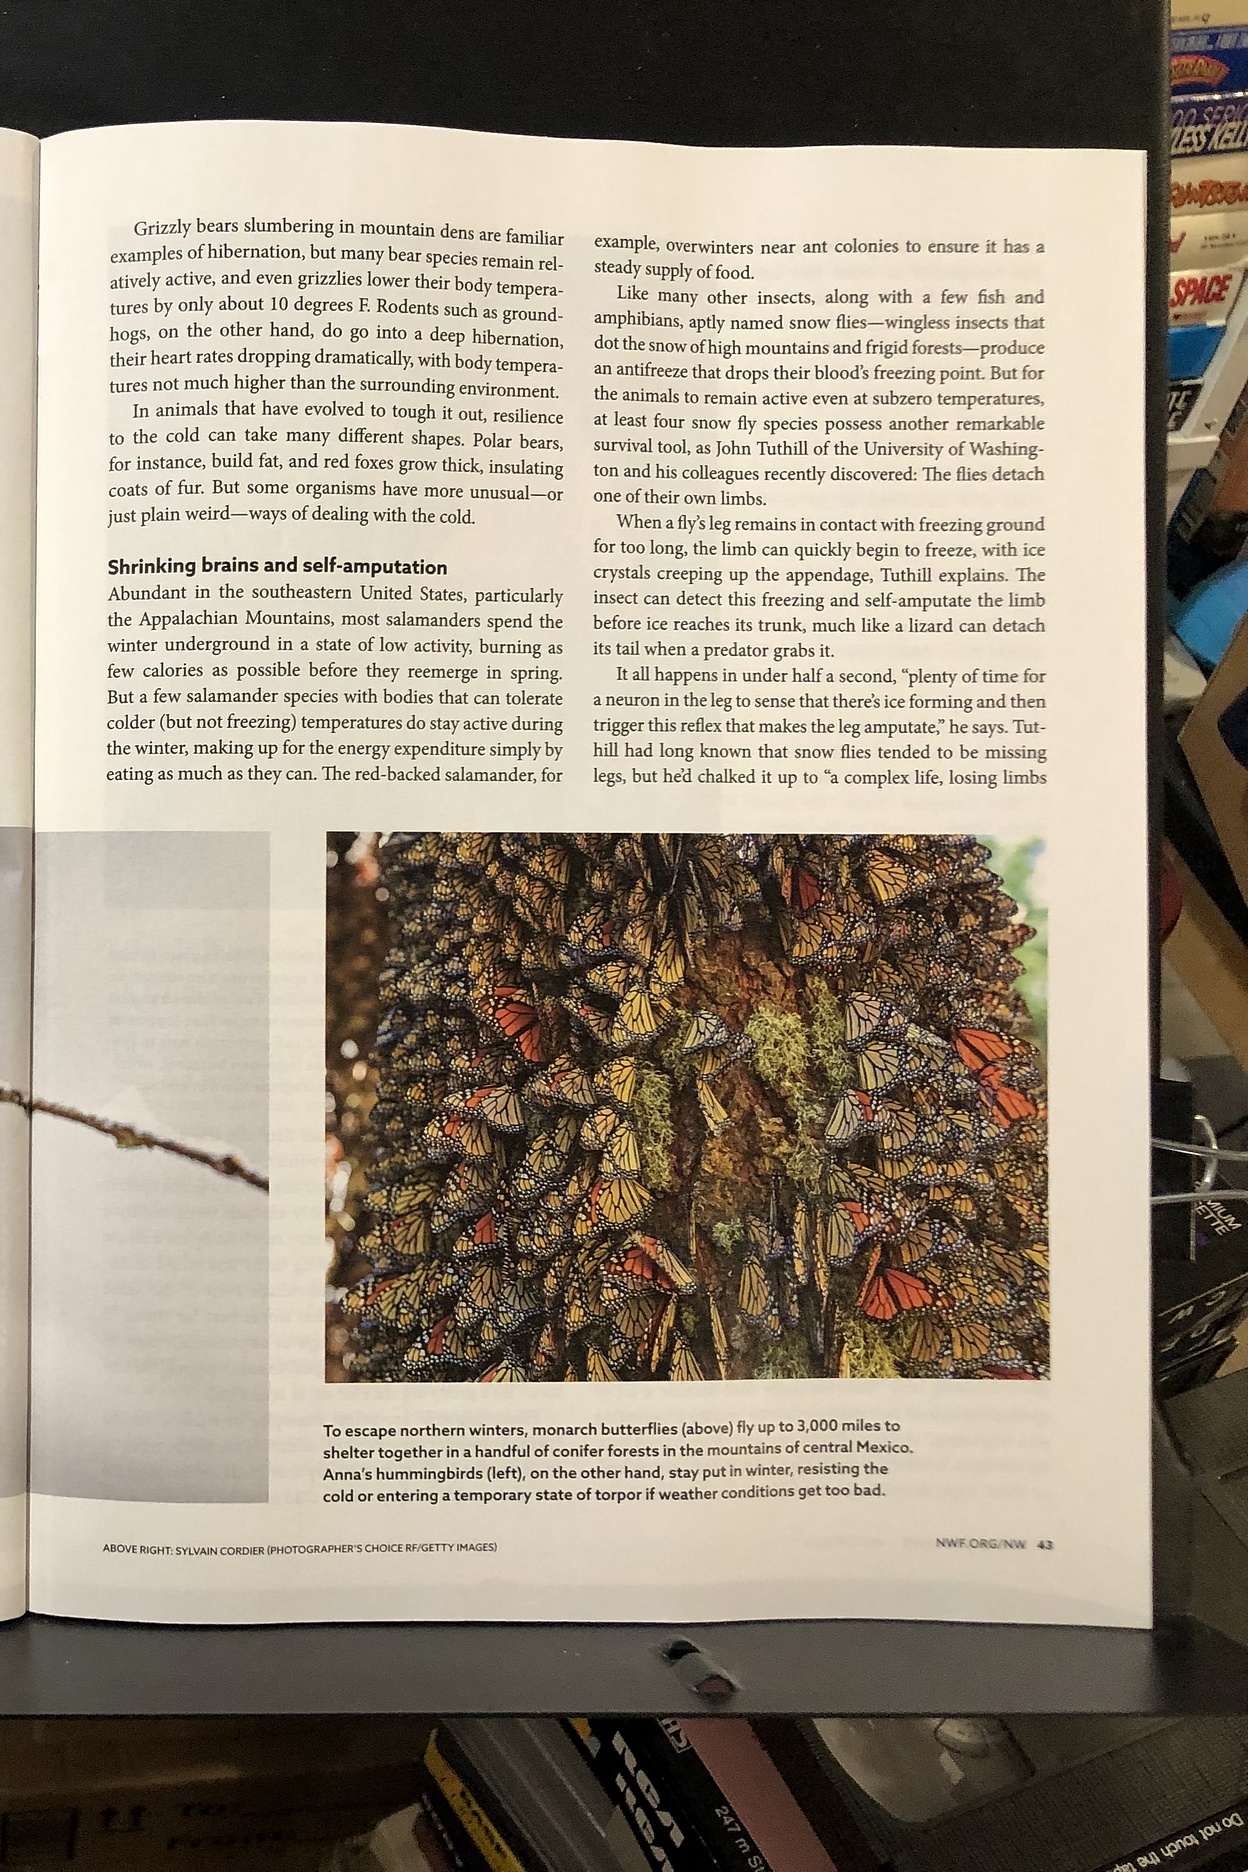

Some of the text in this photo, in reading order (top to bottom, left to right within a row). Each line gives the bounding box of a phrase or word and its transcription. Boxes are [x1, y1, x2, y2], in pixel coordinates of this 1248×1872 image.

[594, 258, 755, 283] steady supply of food.
[1169, 273, 1233, 307] SPACE
[109, 373, 560, 400] tures not much higher than the surrounding environment.
[593, 487, 767, 506] one of their own limbs.
[107, 555, 448, 579] Shrinking brains and self-amputation
[1196, 1204, 1231, 1236] ETTE
[1205, 1200, 1243, 1231] MIUM
[322, 1418, 901, 1441] To escape northern winters, monarch butterflies (above) fly up to 3,000 miles to
[323, 1439, 914, 1463] shelter together in a handful of conifer forests in the mountains of central Mexico.
[376, 1465, 484, 1484] hummingbirds
[486, 1465, 526, 1483] (left),
[530, 1468, 549, 1481] on
[552, 1465, 578, 1480] the
[580, 1465, 622, 1479] other
[624, 1465, 665, 1481] hand,
[668, 1467, 700, 1482] stay
[702, 1466, 727, 1482] put
[729, 1464, 743, 1478] in
[745, 1463, 794, 1478] winter,
[797, 1461, 860, 1478] resisting
[862, 1461, 889, 1475] the
[322, 1482, 886, 1505] cold or entering a temporary state of torpor if weather conditions get too bad.
[102, 1543, 138, 1554] ABOVE
[139, 1545, 174, 1556] RIGHT:
[175, 1546, 218, 1556] SYLVAIN
[219, 1546, 265, 1556] CORDIER
[364, 1543, 404, 1553] CHOICE
[405, 1543, 454, 1553] RF/GETTY
[456, 1542, 498, 1553] IMAGES)
[1036, 1539, 1054, 1551] 43
[611, 1730, 685, 1849] RCA
[714, 1805, 742, 1833] 247
[734, 1836, 752, 1855] m
[1198, 1821, 1223, 1841] not
[1221, 1811, 1245, 1828] Do
[1159, 1833, 1201, 1858] touch
[1136, 1850, 1162, 1868] the
